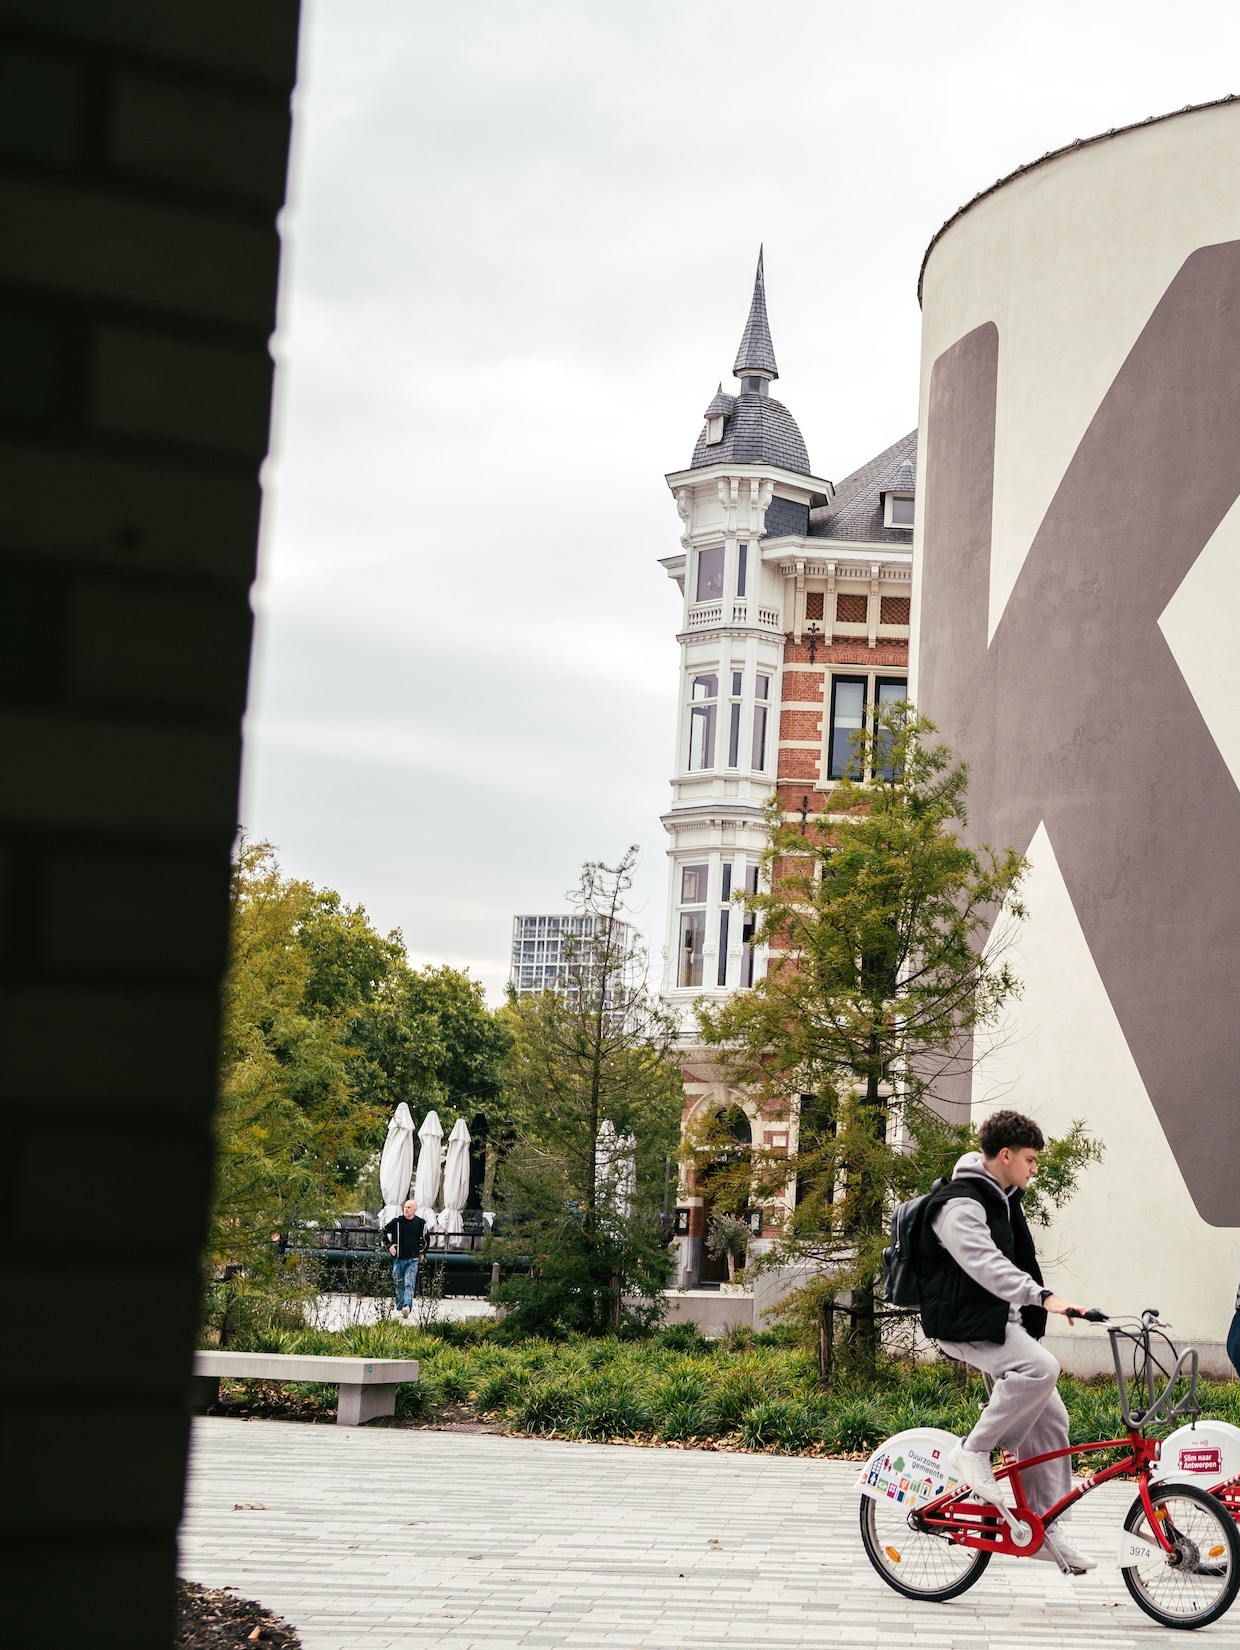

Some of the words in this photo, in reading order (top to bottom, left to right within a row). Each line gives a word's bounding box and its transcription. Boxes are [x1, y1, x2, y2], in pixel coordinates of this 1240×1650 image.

[908, 1449, 941, 1470] Duurzame
[1183, 1454, 1197, 1462] Slim
[911, 1461, 944, 1479] gemeente
[1183, 1461, 1217, 1470] Antwerpen
[1129, 1545, 1150, 1558] 3974
